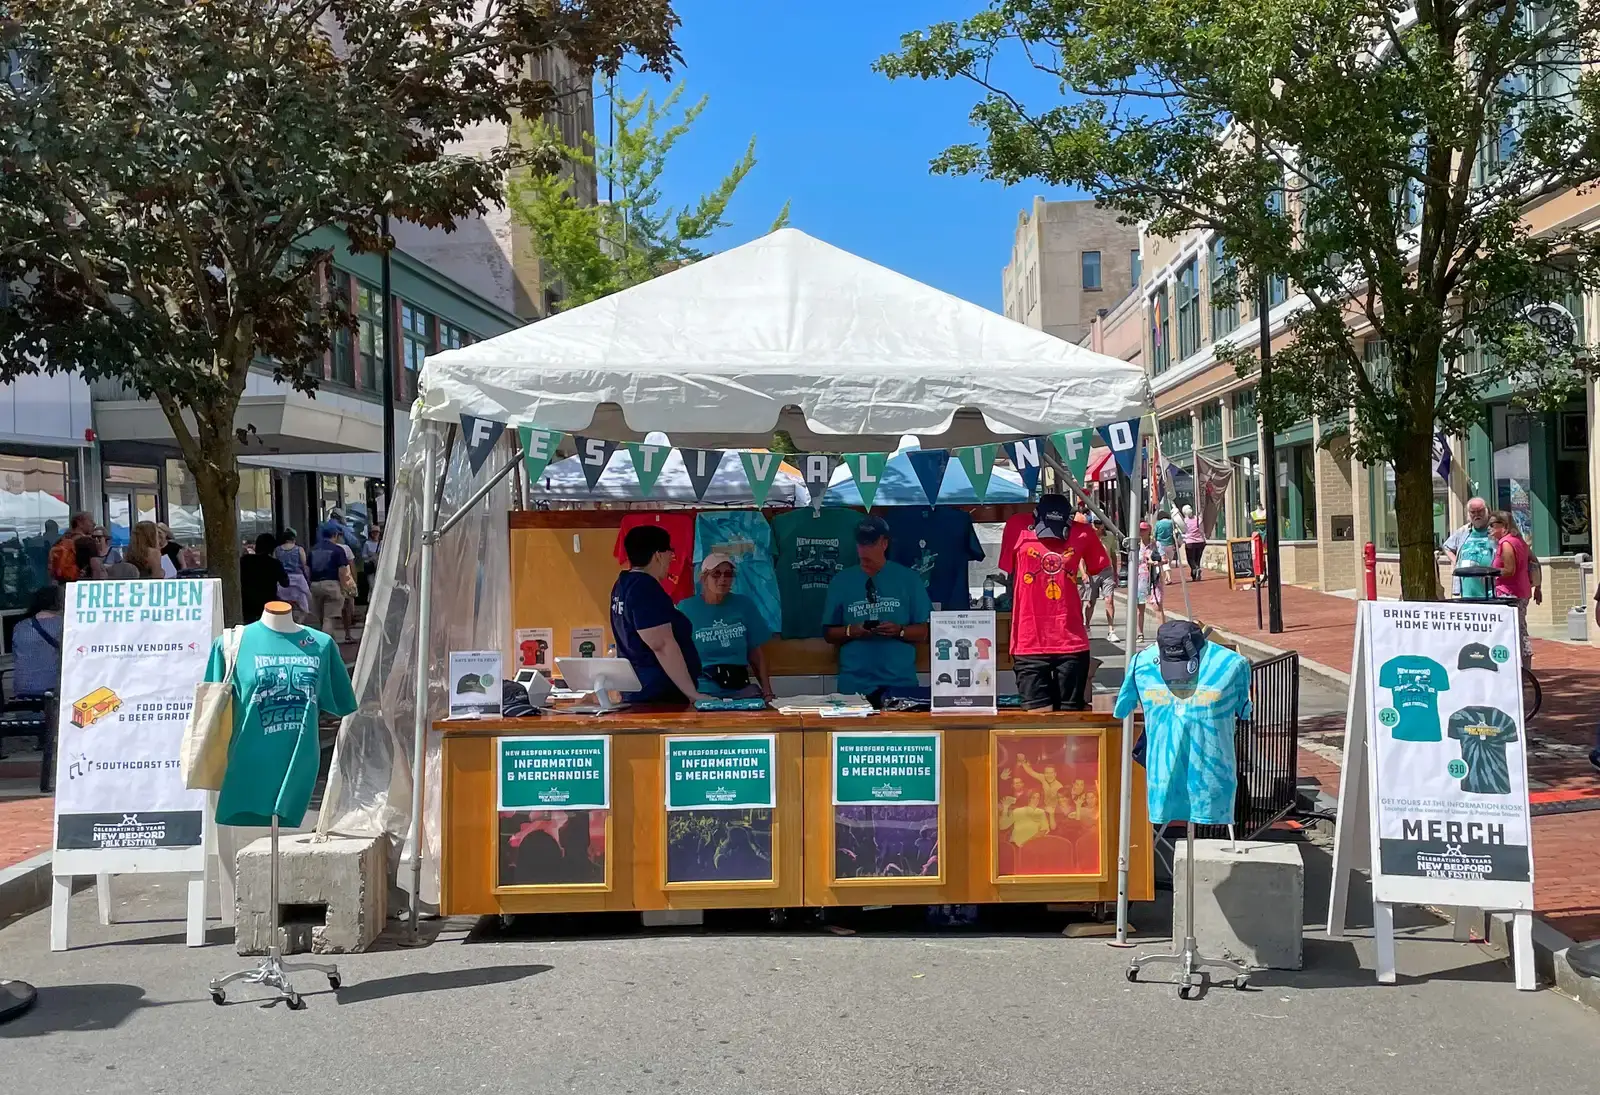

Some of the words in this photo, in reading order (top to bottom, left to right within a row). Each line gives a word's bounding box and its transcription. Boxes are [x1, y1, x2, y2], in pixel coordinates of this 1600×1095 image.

[973, 421, 1135, 475] INFO
[796, 537, 810, 547] NEW
[811, 538, 840, 548] BEDFORD
[76, 582, 126, 609] FREE
[129, 582, 146, 608] &
[149, 581, 203, 607] OPEN
[847, 604, 865, 613] NEW
[865, 601, 901, 610] BEDFORD
[76, 611, 97, 623] TO
[102, 610, 134, 623] THE
[140, 608, 202, 622] PUBLIC
[1383, 609, 1421, 619] BRING
[1424, 610, 1446, 620] THE
[1449, 612, 1504, 623] FESTIVAL
[1395, 620, 1429, 630] HOME
[1432, 621, 1461, 631] WITH
[1464, 623, 1492, 632] YOU!
[695, 630, 713, 640] NEW
[91, 644, 134, 653] ARTISAN
[137, 643, 184, 652] VENDORS
[1492, 648, 1508, 659] $20
[255, 655, 277, 669] NEW
[278, 655, 321, 669] BEDFORD
[136, 703, 163, 712] FOOD
[166, 702, 193, 711] COUR
[128, 713, 154, 722] BEER
[157, 712, 190, 720] GARDE
[1381, 712, 1396, 722] $25
[514, 757, 593, 769] INFORMATION
[681, 757, 759, 769] INFORMATION
[848, 754, 924, 764] INFORMATION
[96, 760, 161, 770] SOUTHCOAST
[165, 760, 180, 768] STA
[1449, 763, 1465, 774] $30
[507, 771, 515, 781] &
[518, 770, 600, 781] MERCHANDISE
[675, 771, 683, 781] &
[685, 769, 766, 781] MERCHANDISE
[842, 767, 849, 776] &
[852, 766, 931, 777] MERCHANDISE
[1397, 798, 1421, 806] YOURS
[1433, 800, 1446, 808] THE
[1446, 801, 1500, 811] INFORMATION
[1500, 804, 1523, 812] KIOSK
[93, 832, 117, 841] NEW
[118, 831, 166, 840] BEDFORD
[1402, 818, 1505, 845] MERCH
[100, 840, 120, 848] FOLK
[121, 838, 157, 847] FESTIVAL
[1416, 855, 1460, 864] CELEBRATING
[1417, 861, 1442, 871] NEW
[1443, 863, 1493, 874] BEDFORD
[1426, 870, 1447, 878] FOLK
[1448, 871, 1485, 880] FESTIVAL
